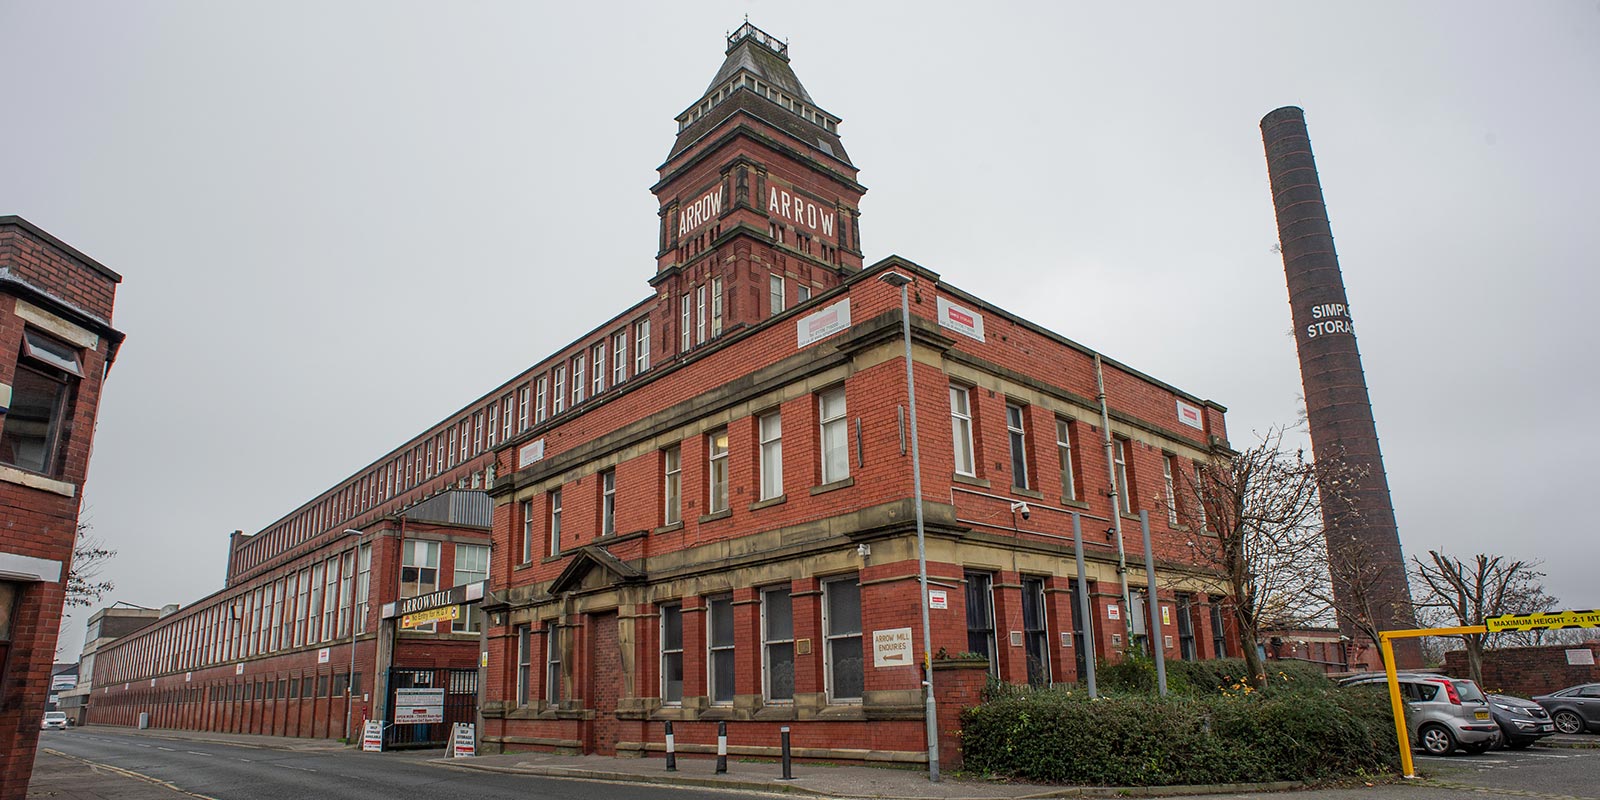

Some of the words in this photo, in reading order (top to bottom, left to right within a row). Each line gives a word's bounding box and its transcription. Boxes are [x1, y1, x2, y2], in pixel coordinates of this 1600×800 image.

[678, 185, 723, 238] ARROW
[769, 186, 834, 237] ARROW
[1312, 303, 1350, 319] SIMPL
[1307, 320, 1353, 338] STORA
[1493, 618, 1532, 627] MAXIMUM
[1533, 616, 1565, 625] HEIGHT
[875, 634, 894, 642] ARROW
[878, 642, 907, 652] ENQUIRIES
